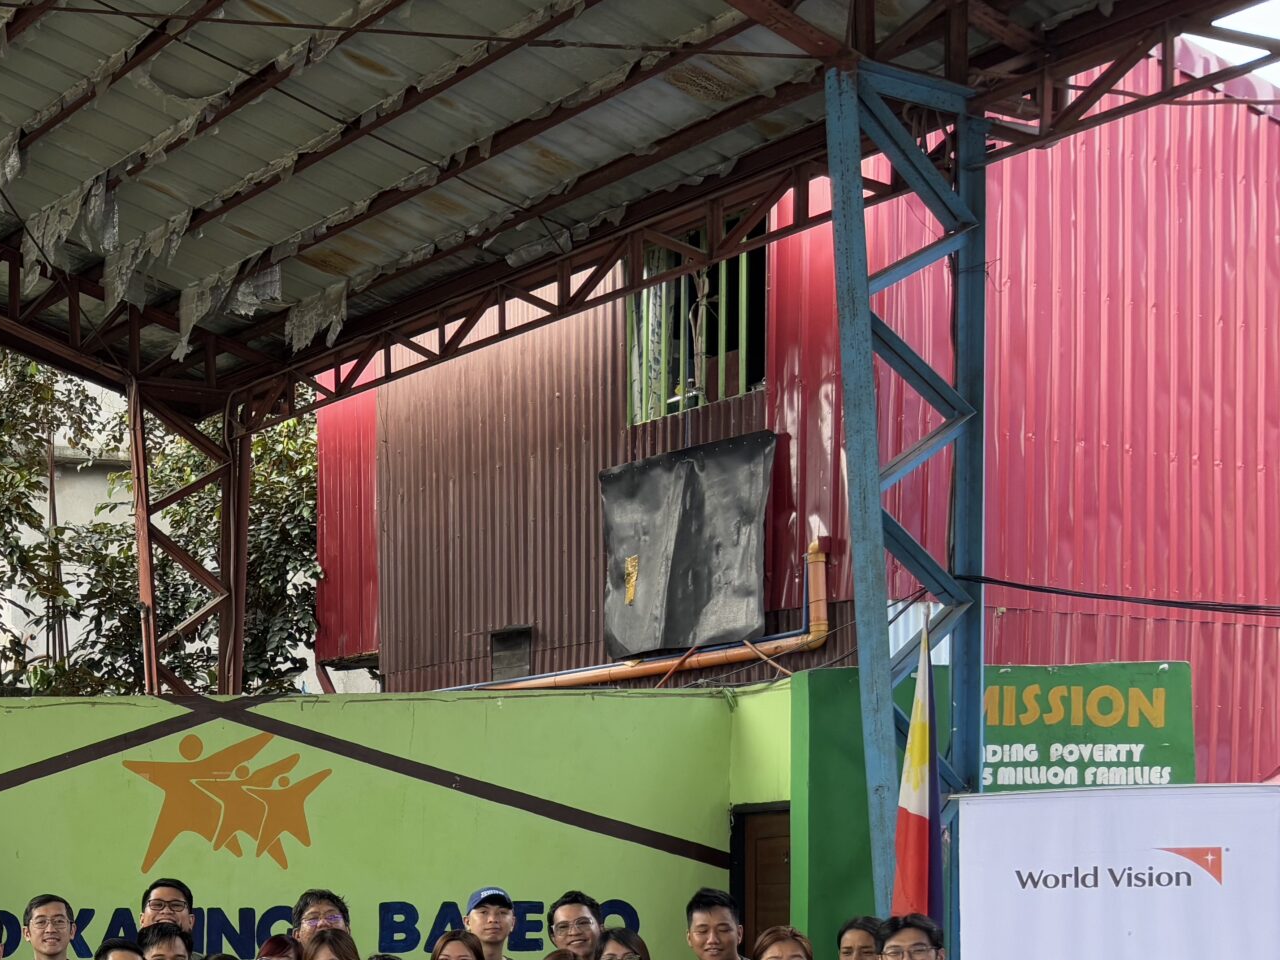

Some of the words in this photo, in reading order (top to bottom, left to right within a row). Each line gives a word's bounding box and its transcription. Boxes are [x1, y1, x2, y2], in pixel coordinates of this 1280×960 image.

[983, 744, 1038, 762] DING
[1050, 744, 1144, 762] POVERTY
[997, 767, 1078, 785] MILLION
[1084, 767, 1171, 785] FAMILIES
[1015, 866, 1099, 890] World
[1107, 866, 1193, 888] Vision
